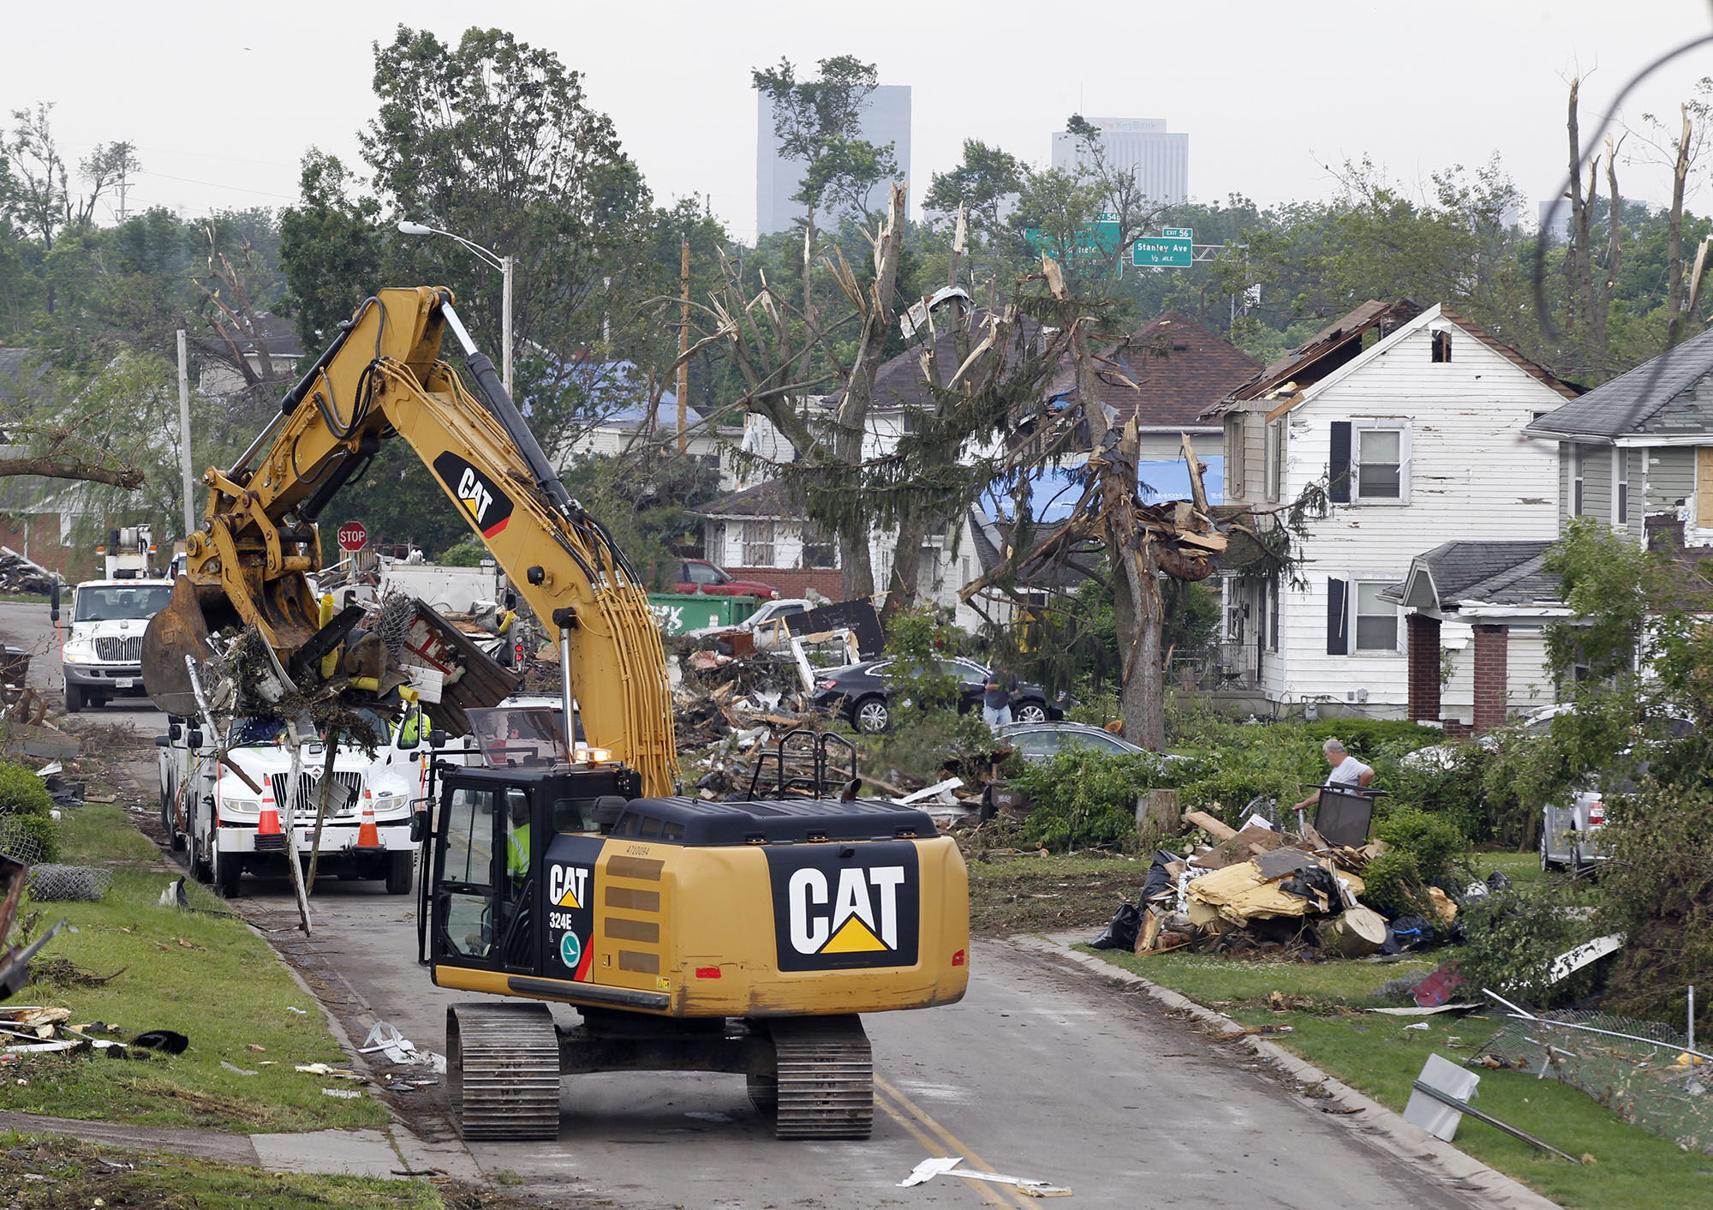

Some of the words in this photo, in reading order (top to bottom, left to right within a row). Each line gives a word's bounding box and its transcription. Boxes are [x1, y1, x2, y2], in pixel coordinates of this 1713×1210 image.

[1115, 120, 1155, 131] KeyBank
[1137, 243, 1169, 253] Stanley
[1172, 243, 1188, 252] Ave
[457, 467, 494, 524] CAT
[340, 530, 365, 542] STOP
[549, 864, 589, 909] CAT
[788, 865, 905, 955] CAT
[549, 911, 572, 930] 324E
